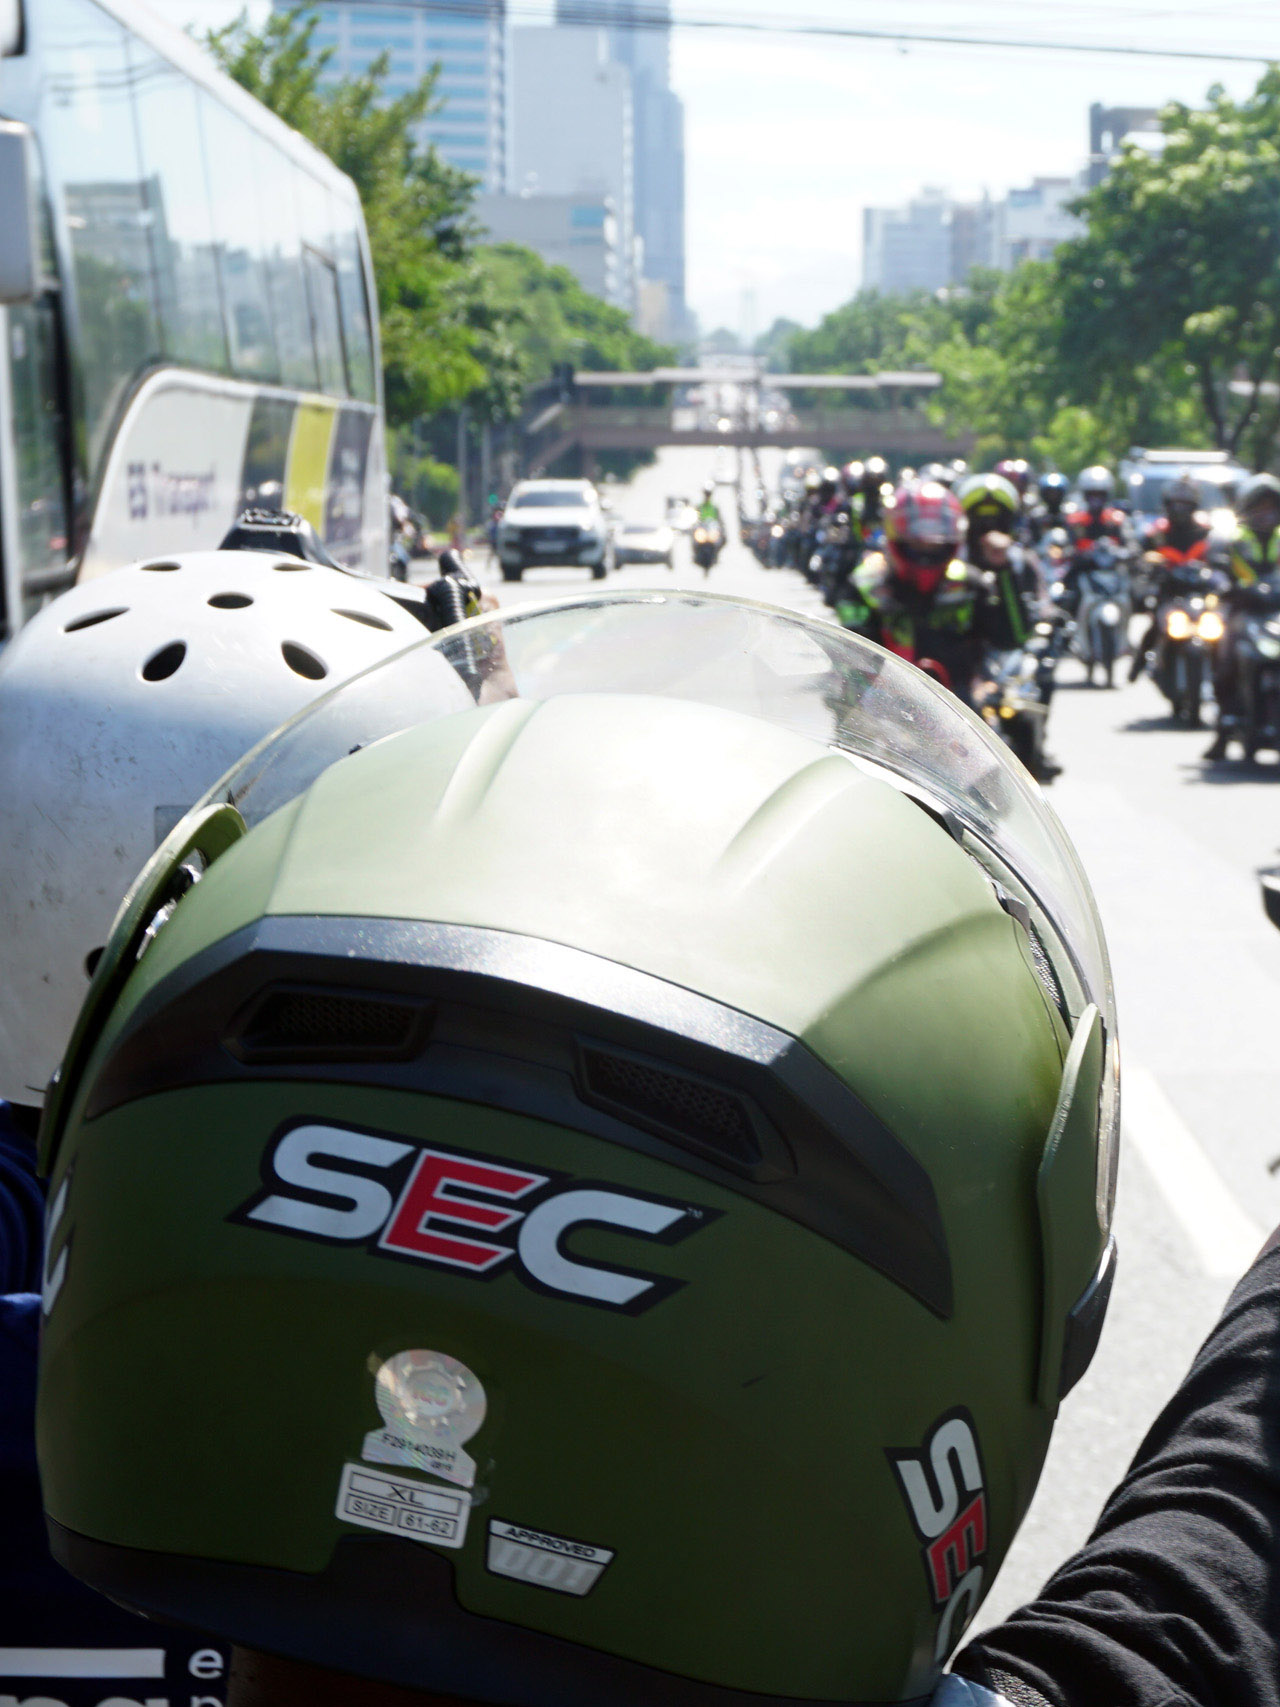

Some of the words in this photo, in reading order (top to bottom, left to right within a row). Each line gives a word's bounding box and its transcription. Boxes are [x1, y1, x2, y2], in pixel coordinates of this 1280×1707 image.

[247, 1124, 688, 1305] SEC
[387, 1484, 424, 1506] XL
[352, 1499, 390, 1521] SIZE
[404, 1513, 451, 1536] 61-62
[504, 1526, 597, 1558] APPROVED
[896, 1418, 984, 1664] SEC
